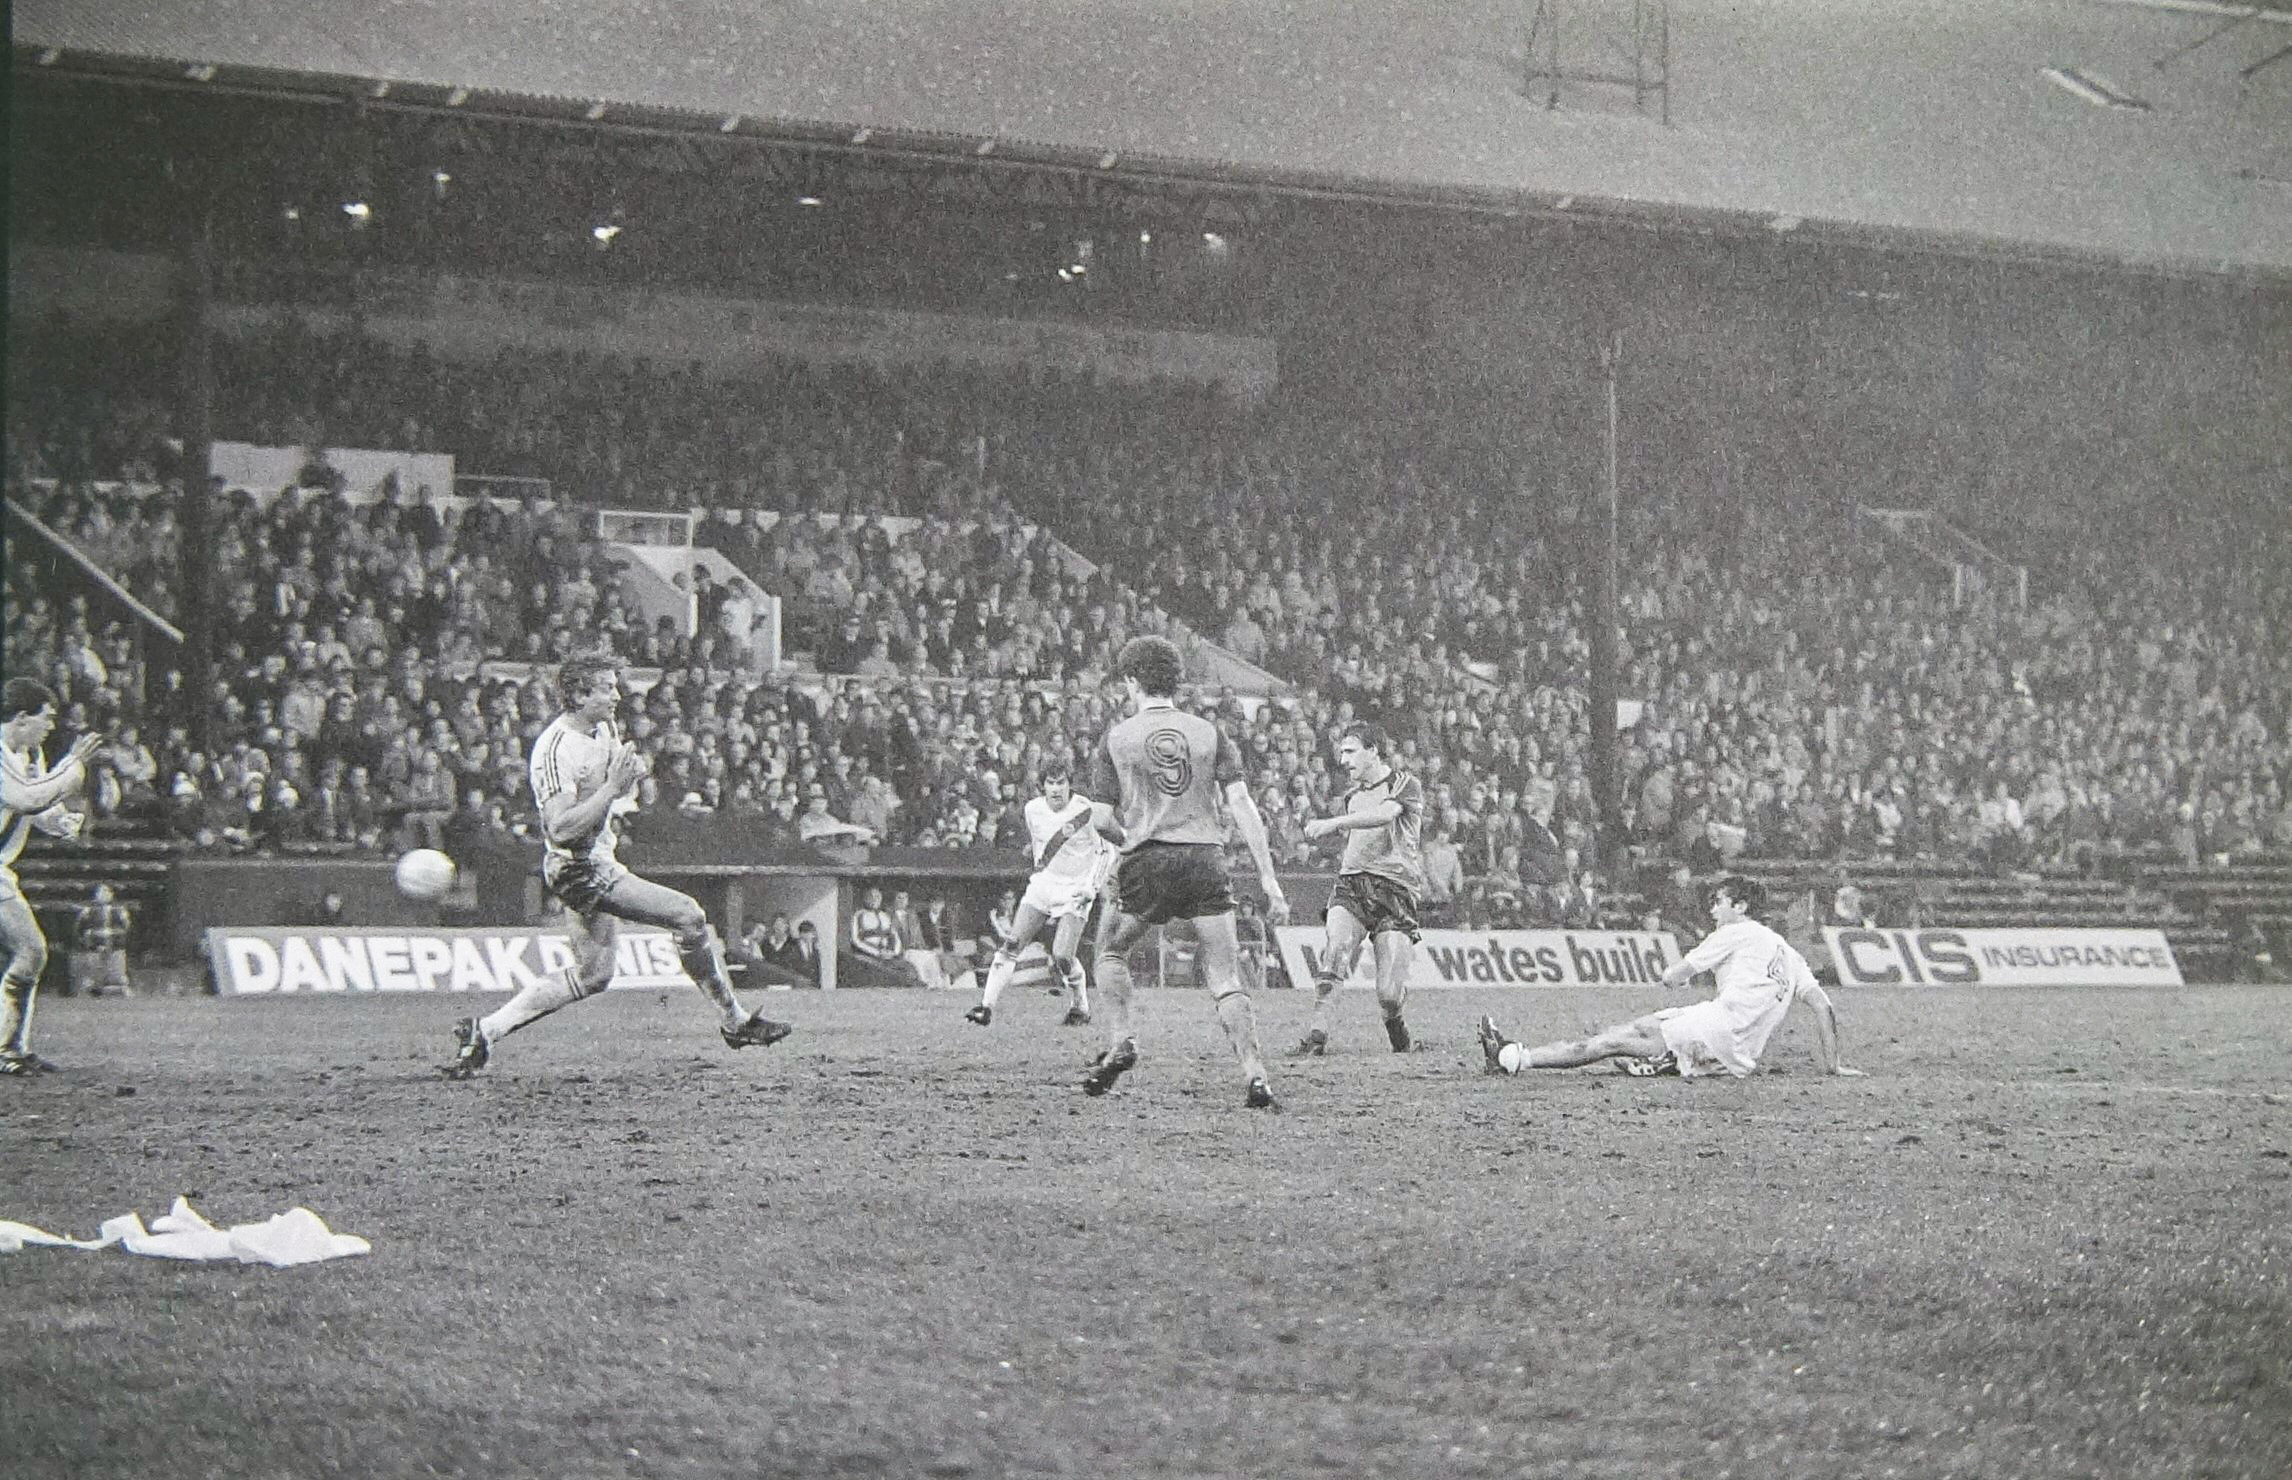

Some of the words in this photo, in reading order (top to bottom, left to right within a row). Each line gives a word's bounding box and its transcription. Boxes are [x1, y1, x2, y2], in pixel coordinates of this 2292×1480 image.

[1145, 728, 1193, 797] 9
[226, 936, 538, 992] DANEPAK
[1427, 938, 1564, 983] wates
[1566, 935, 1669, 984] build
[1838, 930, 1980, 983] CIS
[1981, 945, 2173, 969] INSURANCE
